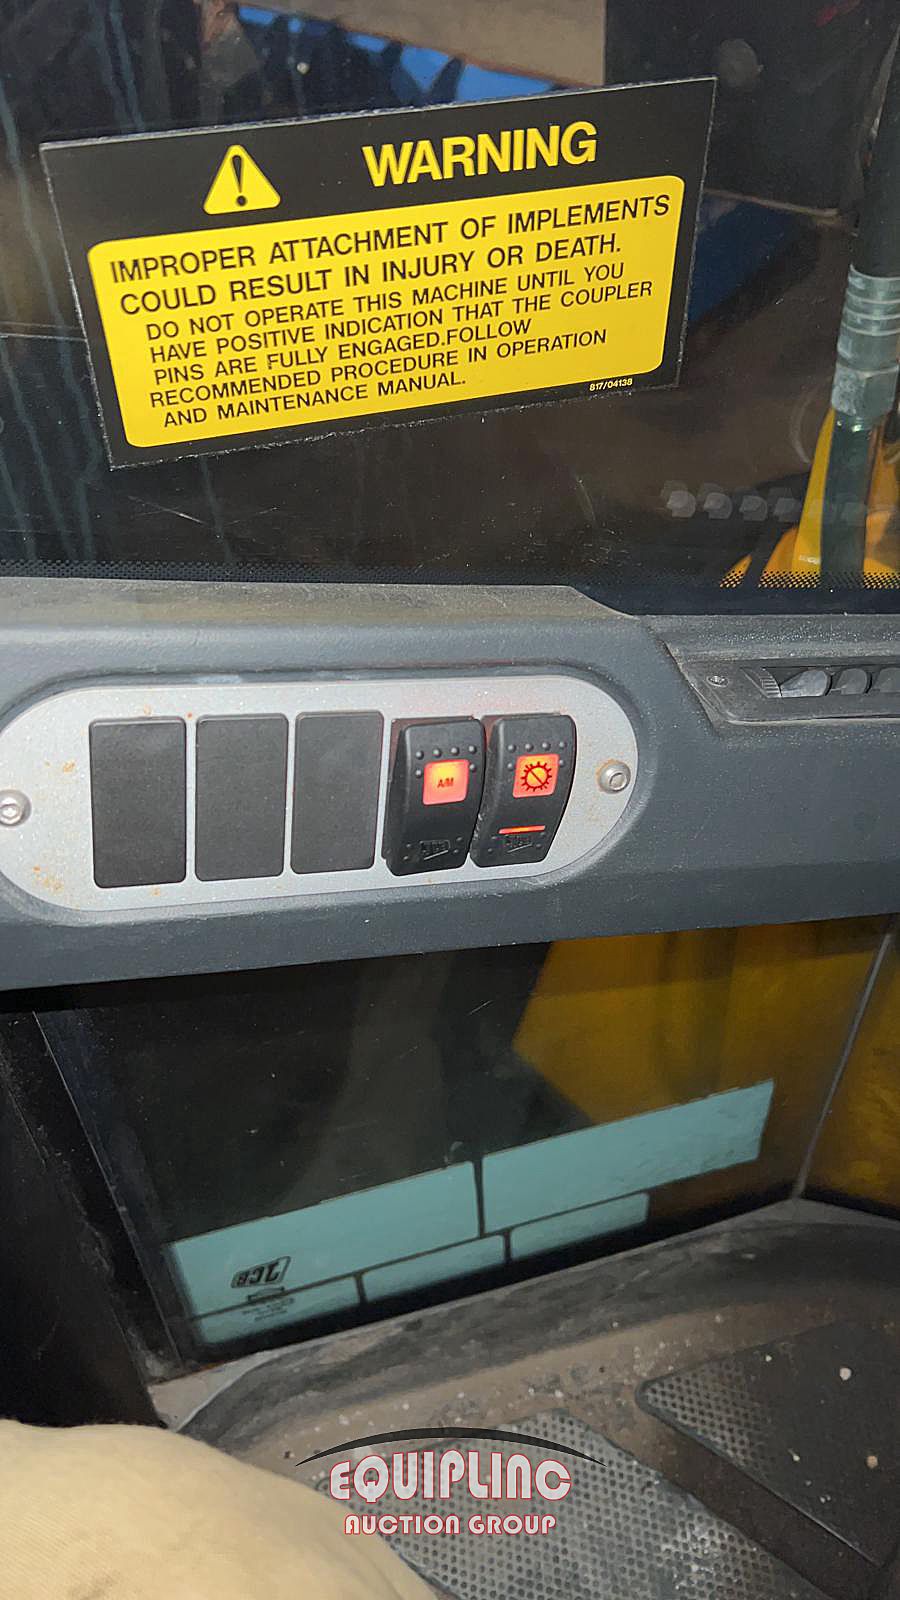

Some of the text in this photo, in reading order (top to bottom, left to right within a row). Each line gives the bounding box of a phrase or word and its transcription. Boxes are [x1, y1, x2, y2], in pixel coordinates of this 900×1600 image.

[362, 121, 597, 187] WARNING
[110, 193, 670, 283] IMPROPER ATTACHMENT OF IMPLEMENTS
[120, 232, 621, 316] COULD RESULT IN INJURY OR DEATH.
[146, 262, 624, 341] DO NOT OPERATE THIS MACHINE UNTIL YOU
[150, 280, 653, 364] HAVE POSITIVE INDICATION THAT THE COUPLER
[150, 328, 607, 408] RECOMMENDED PROCEDURE IN OPERATION
[155, 364, 204, 385] PINS
[214, 355, 257, 377] ARE
[267, 346, 328, 371] FULLY
[164, 372, 466, 427] AND MAINTENANCE MANUAL.
[589, 378, 633, 392] 817/04138
